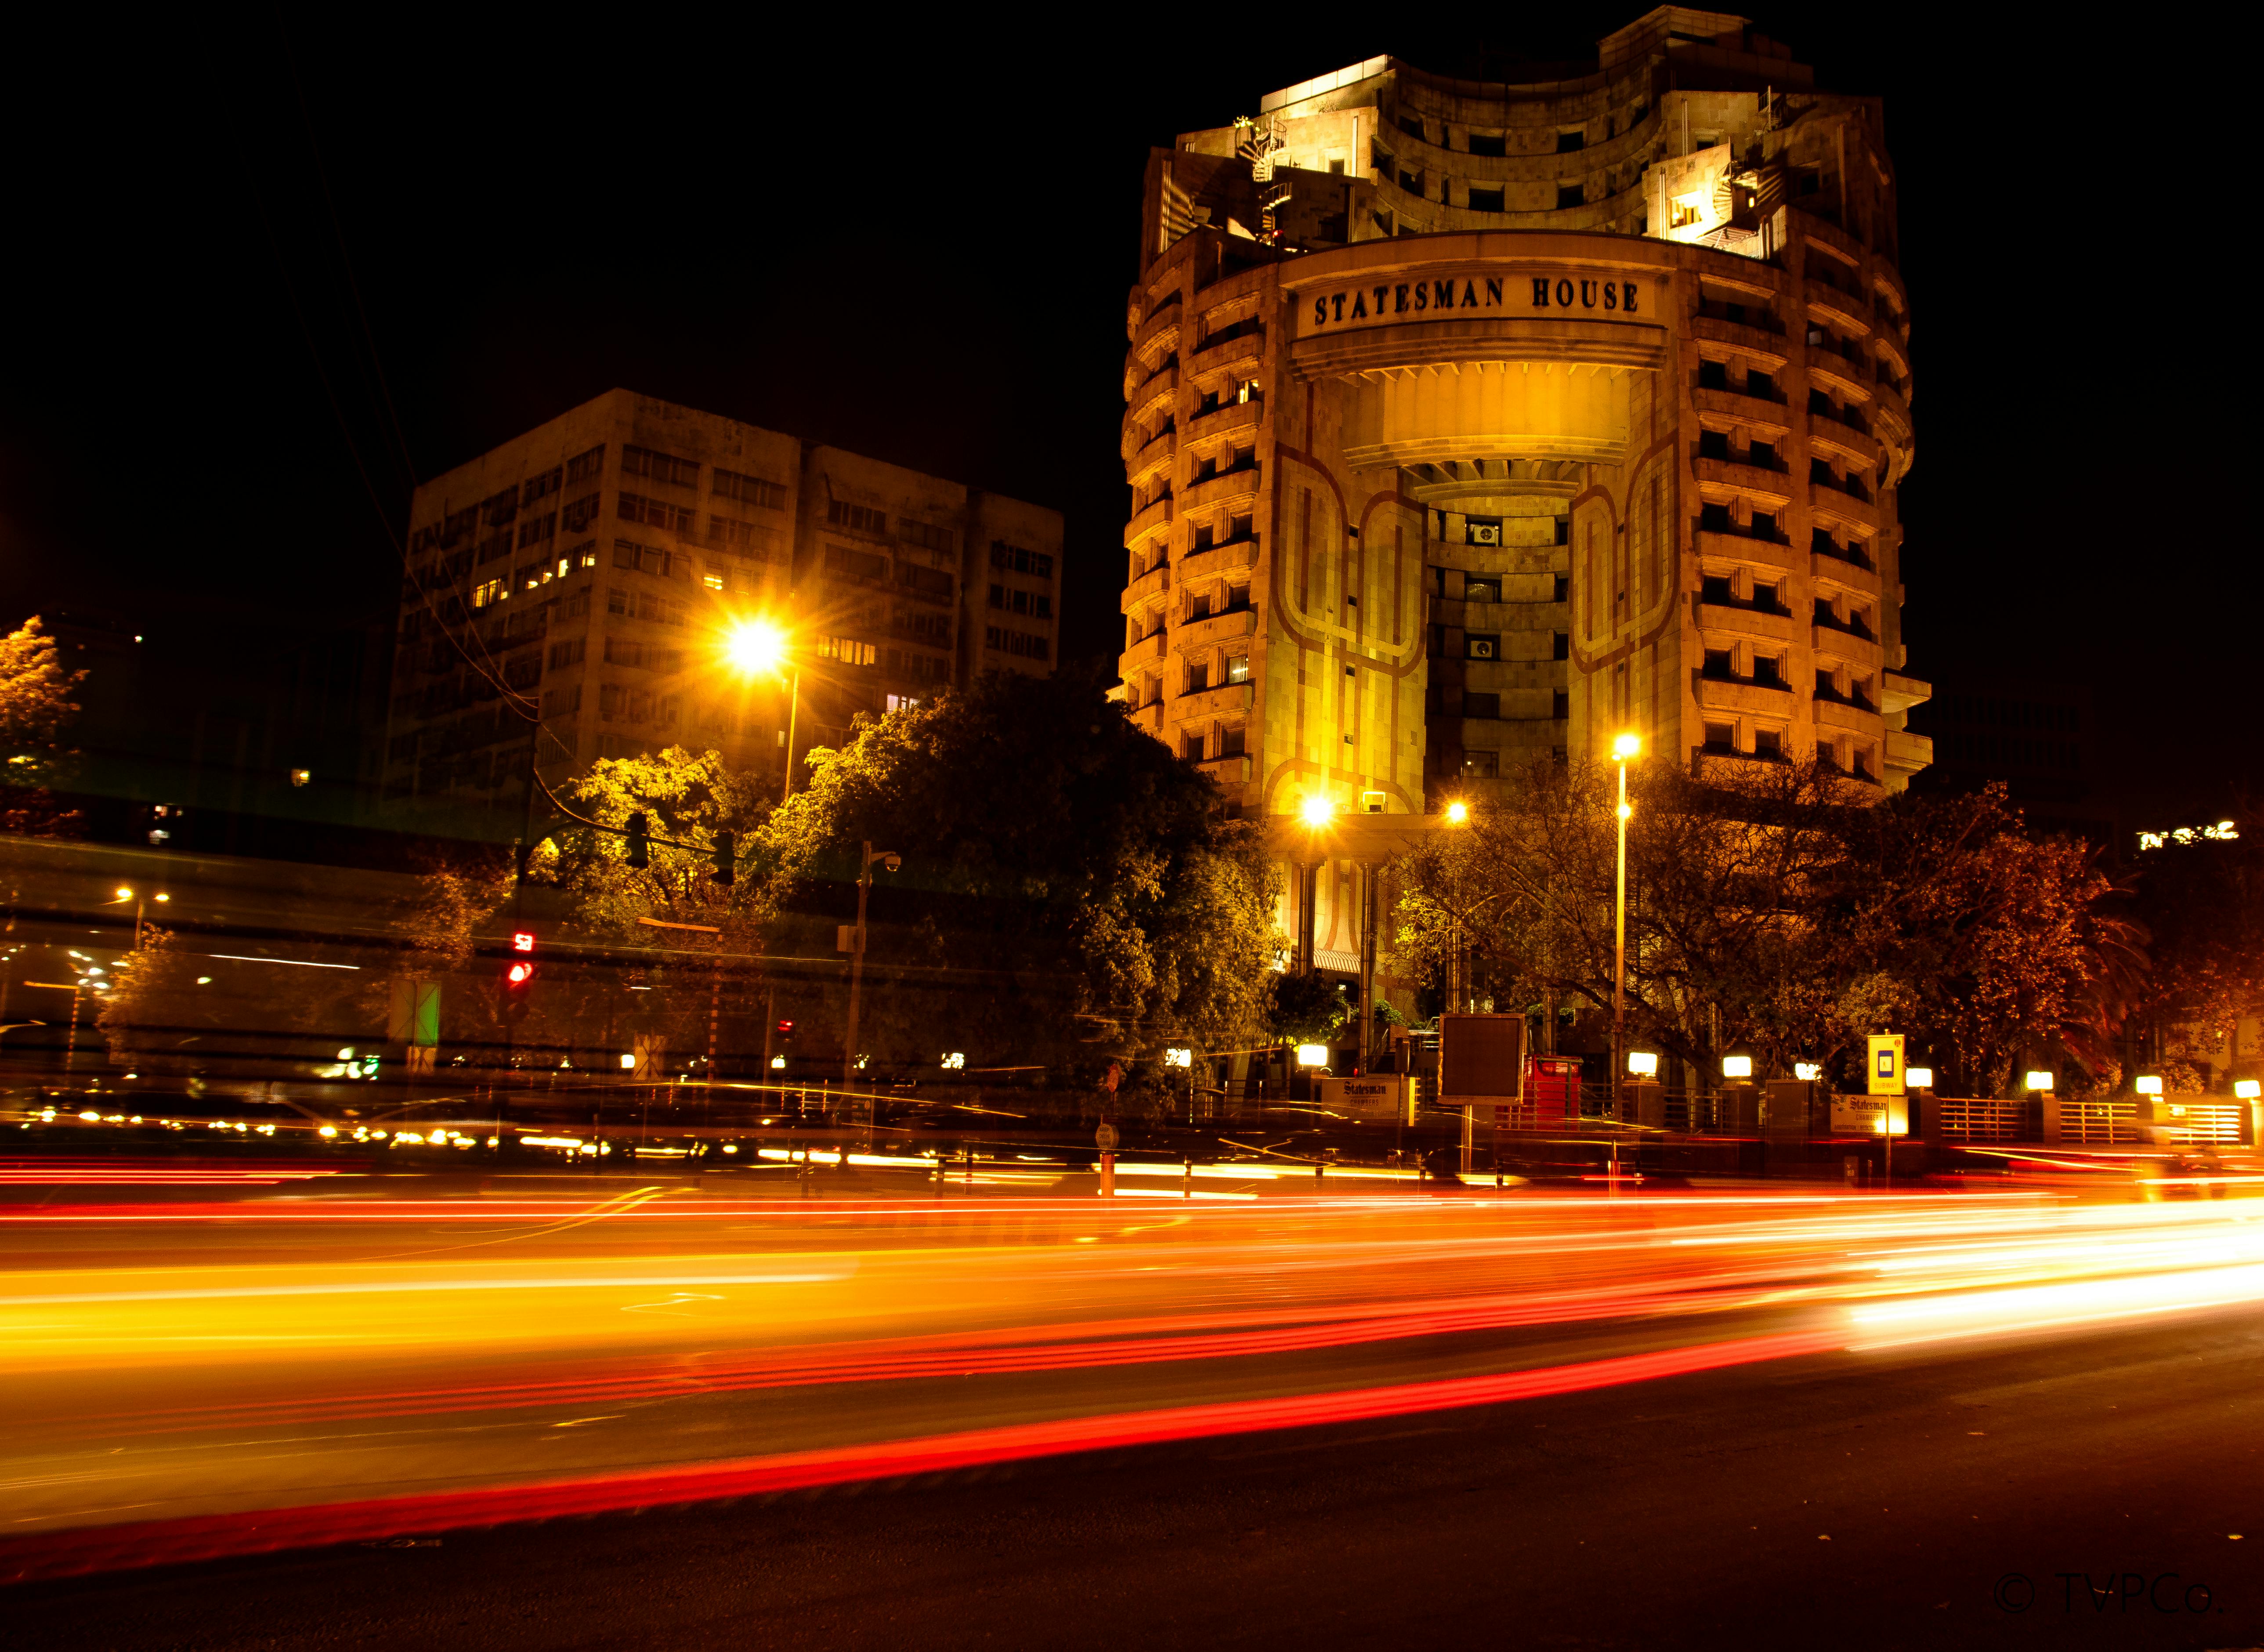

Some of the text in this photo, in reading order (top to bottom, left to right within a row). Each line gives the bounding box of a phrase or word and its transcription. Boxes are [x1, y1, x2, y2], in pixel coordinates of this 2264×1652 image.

[1314, 278, 1638, 326] STATESMAN HOUSE
[1343, 1081, 1386, 1095] Statesman
